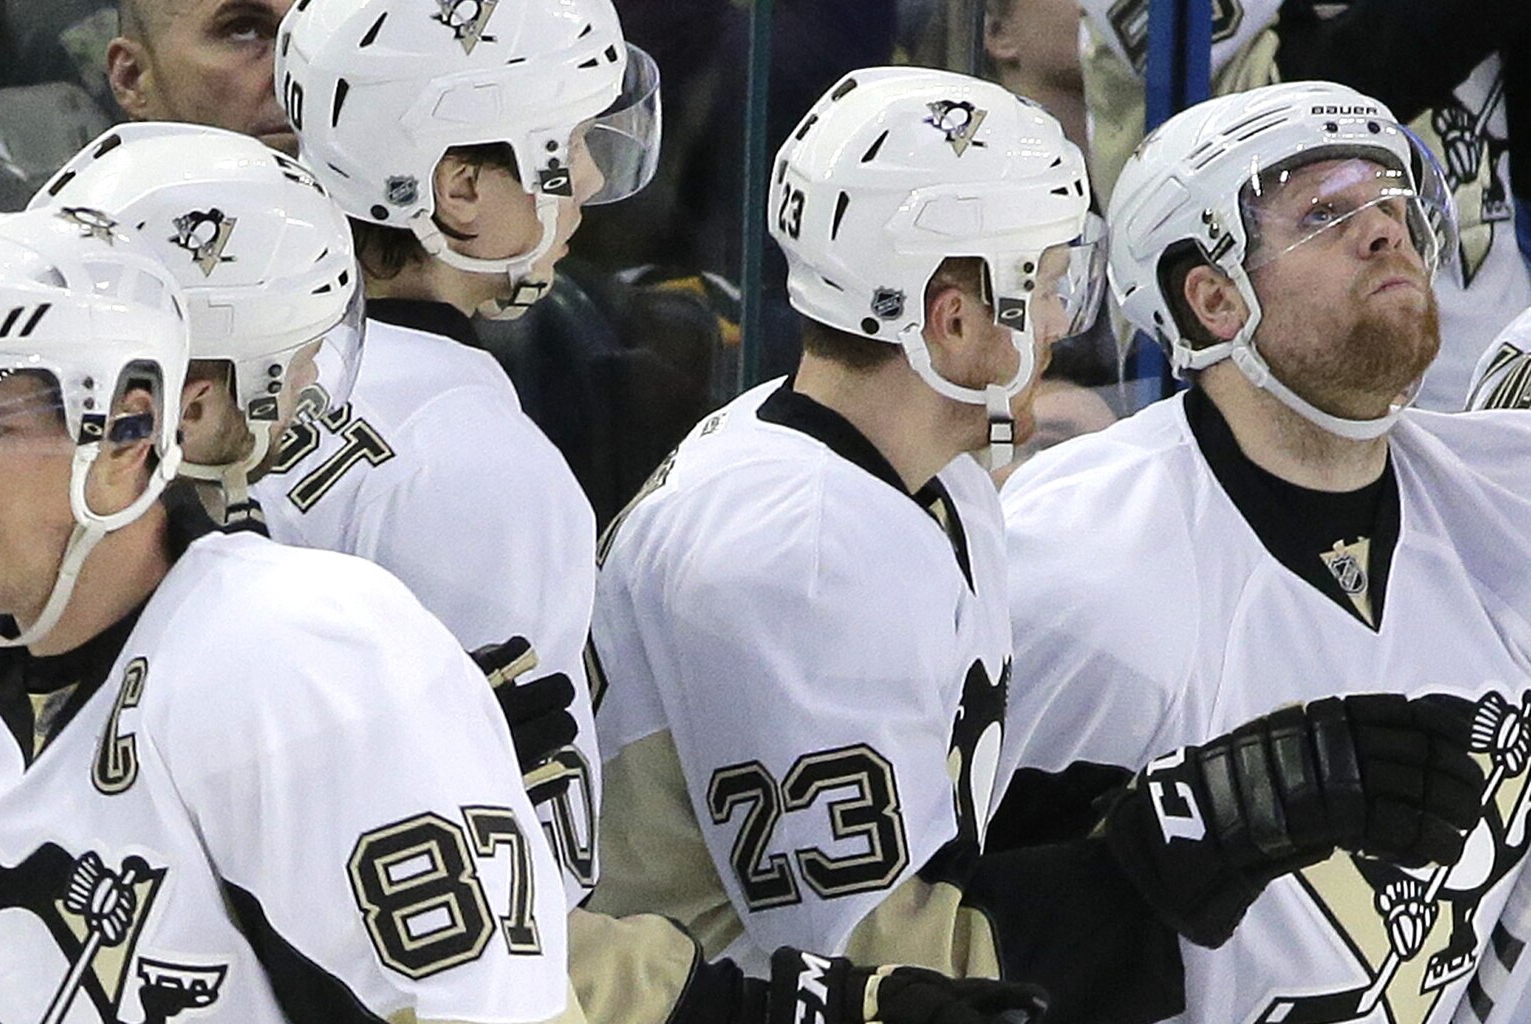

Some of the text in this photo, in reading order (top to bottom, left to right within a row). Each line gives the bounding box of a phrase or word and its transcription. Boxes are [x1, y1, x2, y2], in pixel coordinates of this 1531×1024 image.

[1311, 105, 1378, 115] BAUER
[779, 182, 806, 241] 23
[90, 656, 149, 796] C
[346, 804, 543, 981] 87
[706, 742, 910, 913] 23
